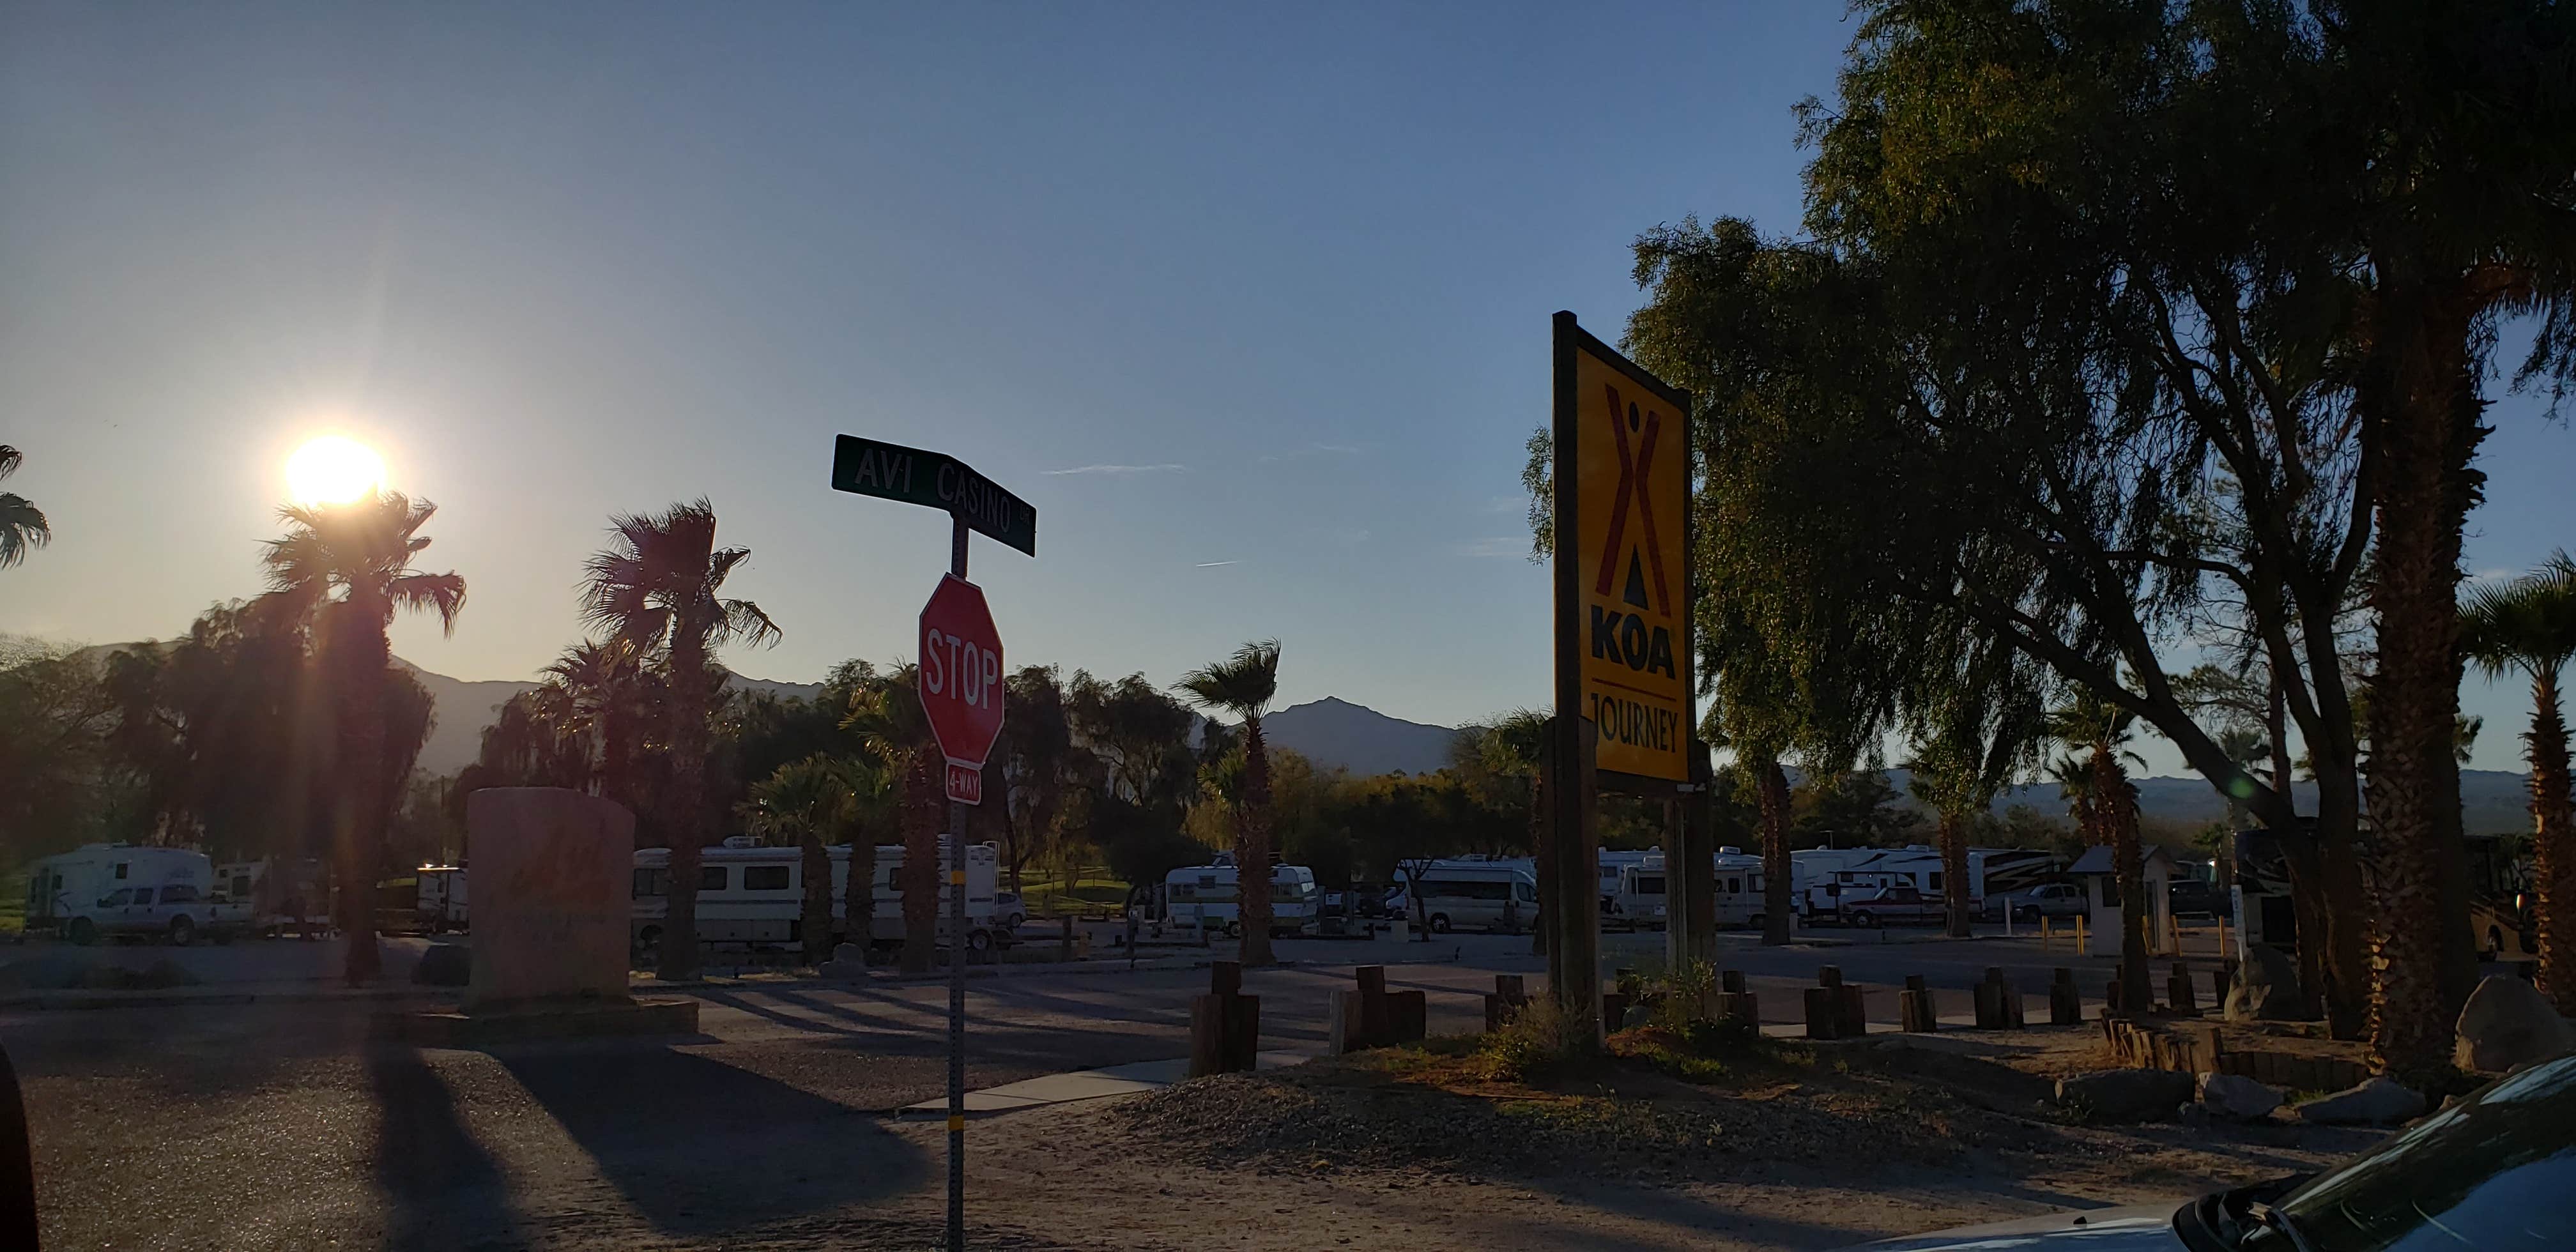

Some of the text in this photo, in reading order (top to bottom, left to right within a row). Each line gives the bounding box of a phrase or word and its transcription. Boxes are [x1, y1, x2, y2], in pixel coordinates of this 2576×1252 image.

[854, 448, 914, 494] AVI
[937, 462, 1011, 533] CASINO
[926, 628, 999, 709] STOP
[1591, 604, 1676, 680] KOA
[1591, 692, 1678, 753] JOURNEY
[949, 771, 978, 795] 4-WAY
